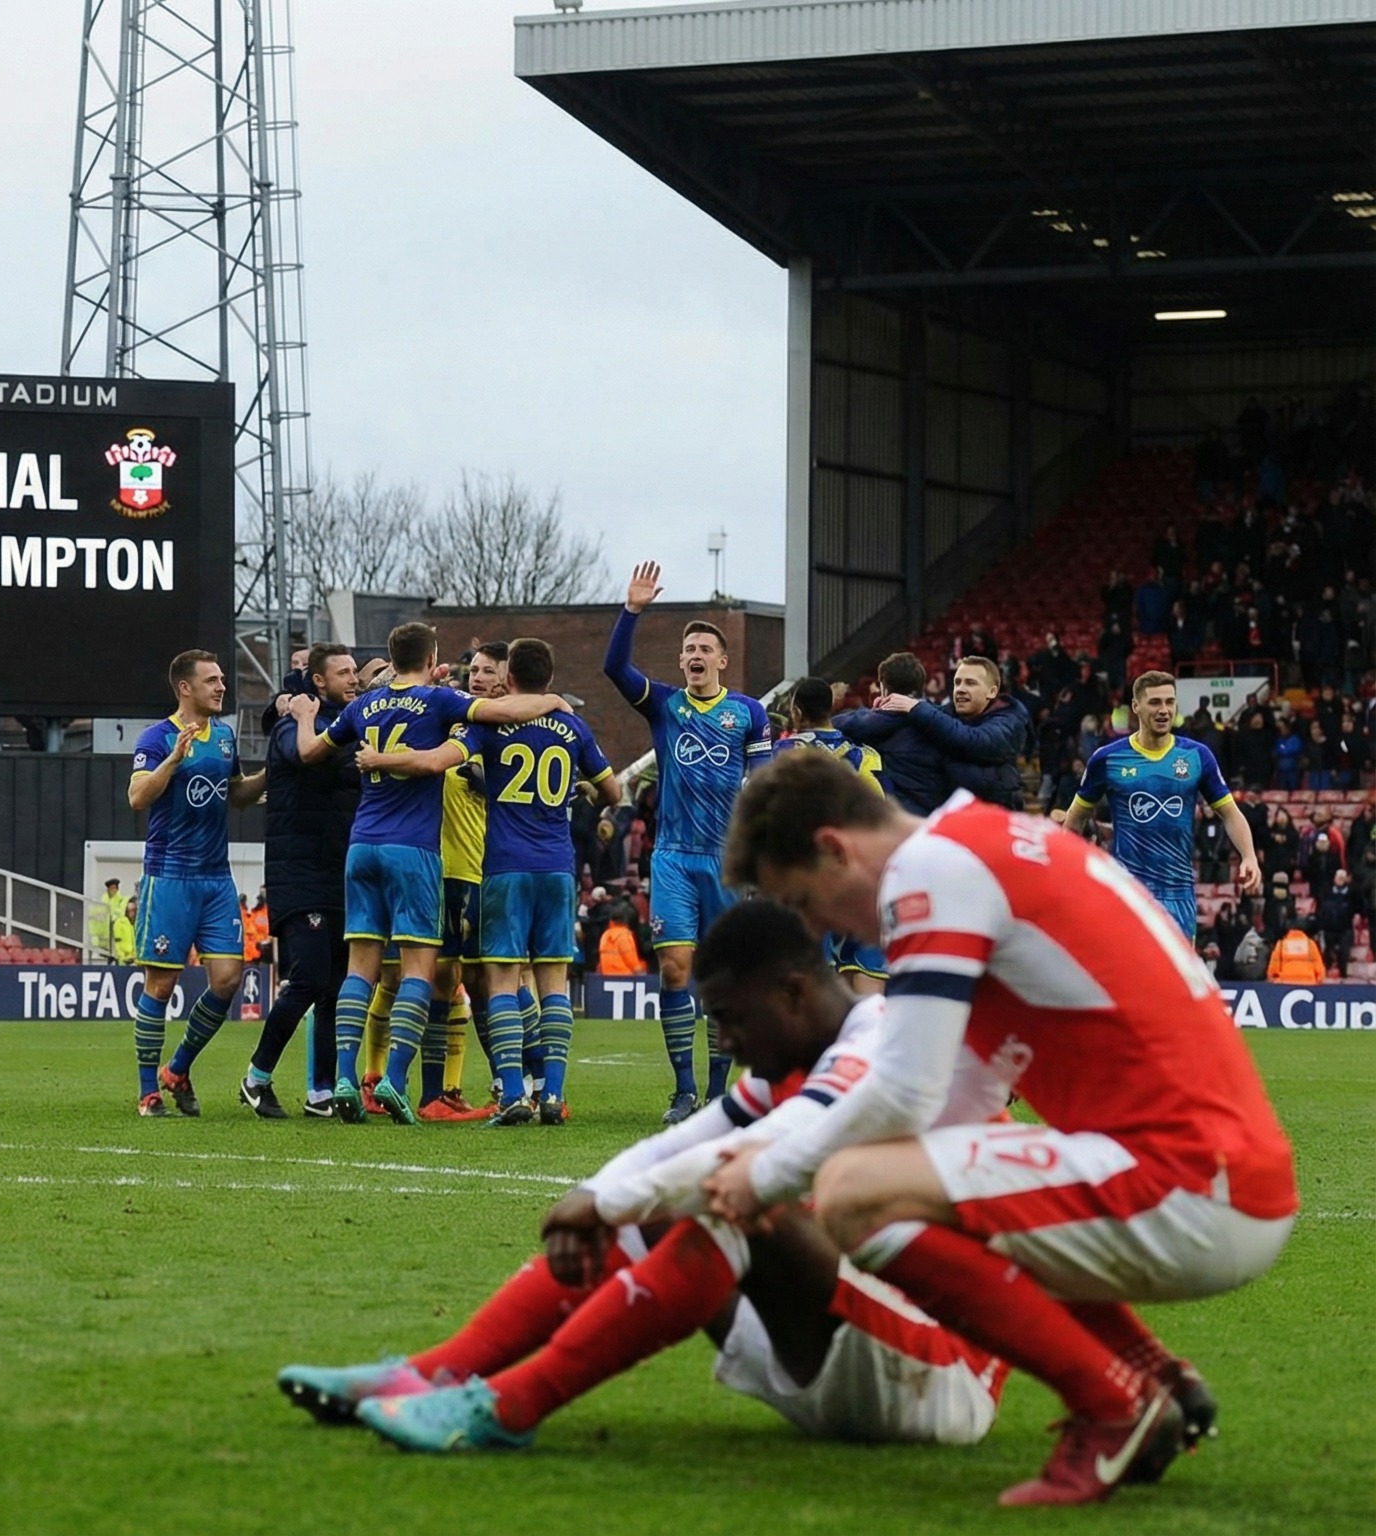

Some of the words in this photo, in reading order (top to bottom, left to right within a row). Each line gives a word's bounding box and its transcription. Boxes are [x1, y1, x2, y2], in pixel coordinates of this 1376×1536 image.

[497, 743, 571, 807] 20
[18, 971, 77, 1019] The
[81, 971, 120, 1018] FA
[125, 971, 184, 1021] Cp
[604, 981, 695, 1020] Th
